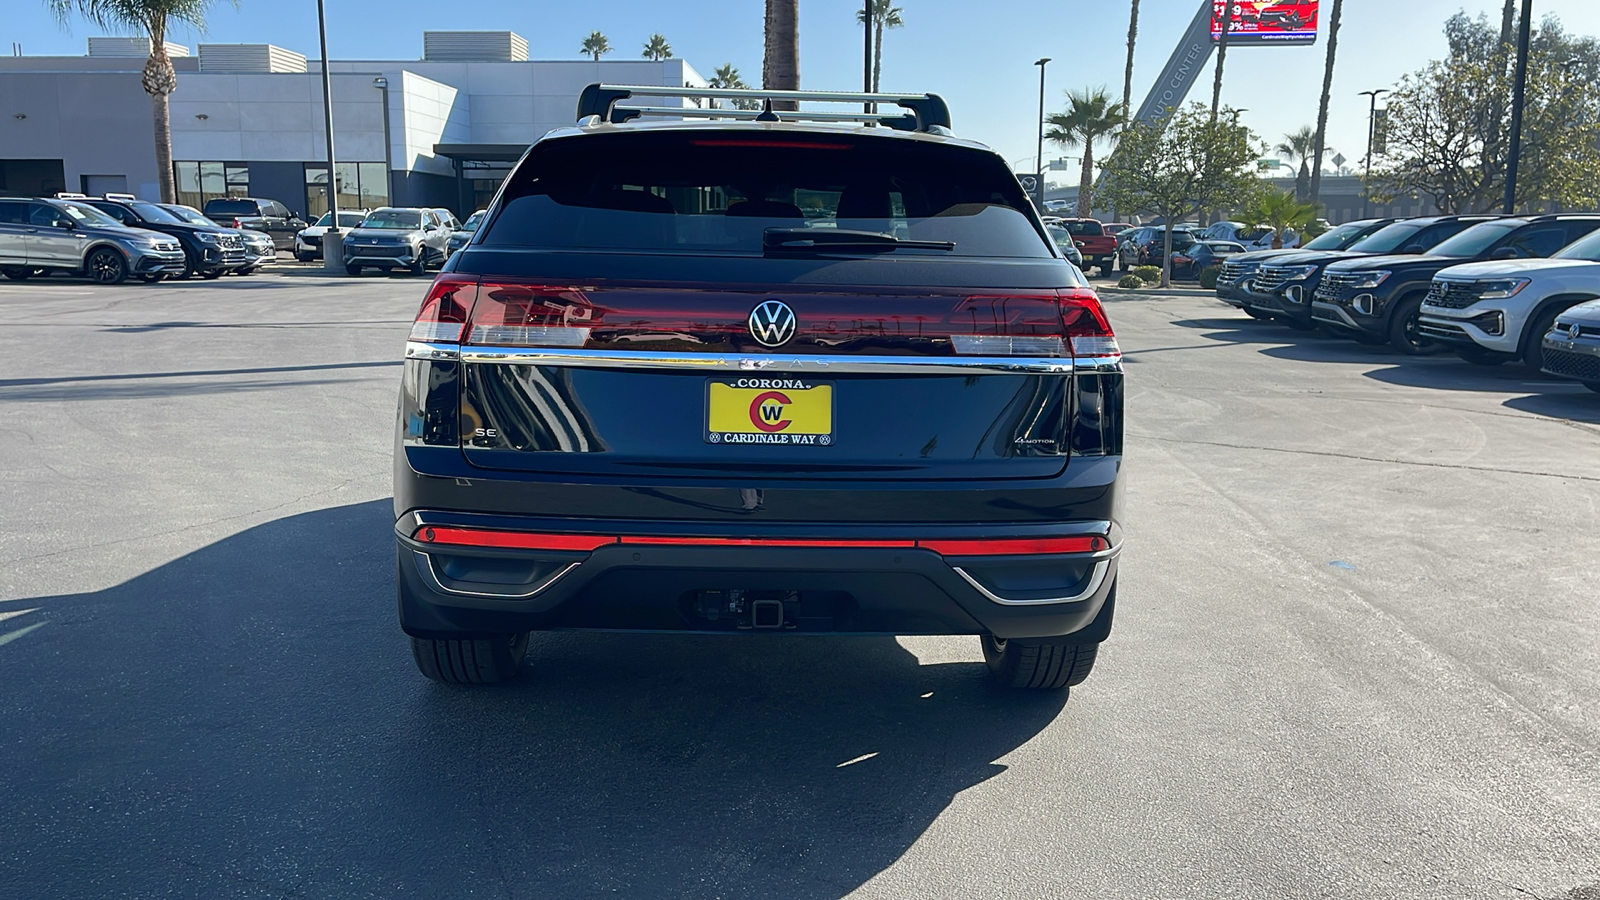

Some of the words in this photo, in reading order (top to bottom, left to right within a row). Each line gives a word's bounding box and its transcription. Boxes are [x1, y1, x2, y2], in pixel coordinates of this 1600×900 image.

[1150, 90, 1173, 123] AUTO
[1171, 43, 1203, 89] CENTER
[737, 378, 805, 389] CORONA
[475, 428, 497, 437] SE
[724, 433, 789, 444] CARDINALE
[791, 434, 817, 444] WAY
[1014, 436, 1055, 444] 4MOTION
